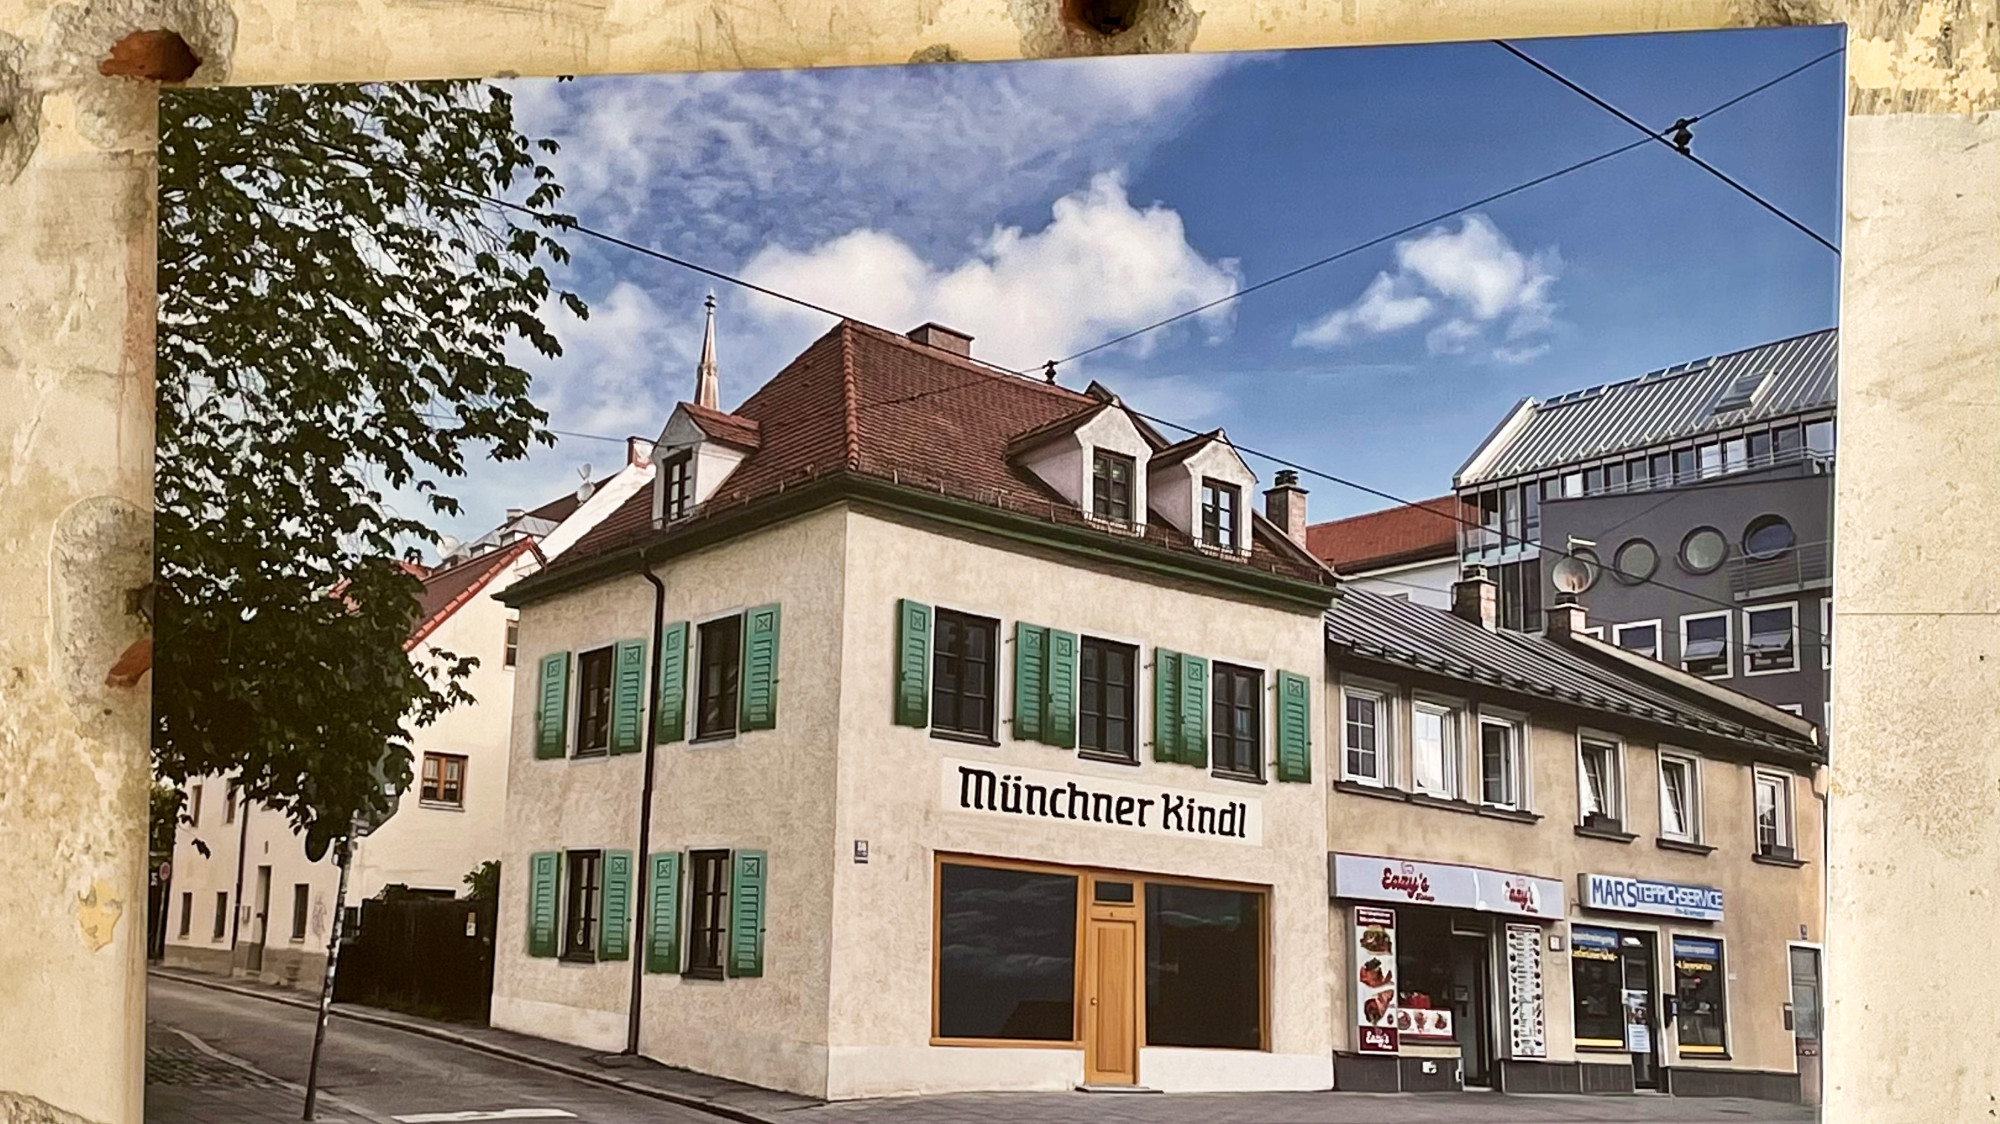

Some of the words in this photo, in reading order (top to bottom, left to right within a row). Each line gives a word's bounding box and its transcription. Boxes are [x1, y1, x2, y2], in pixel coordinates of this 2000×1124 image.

[958, 766, 1155, 827] Münchner
[1161, 793, 1246, 838] Kindl
[1592, 877, 1637, 908] MARS
